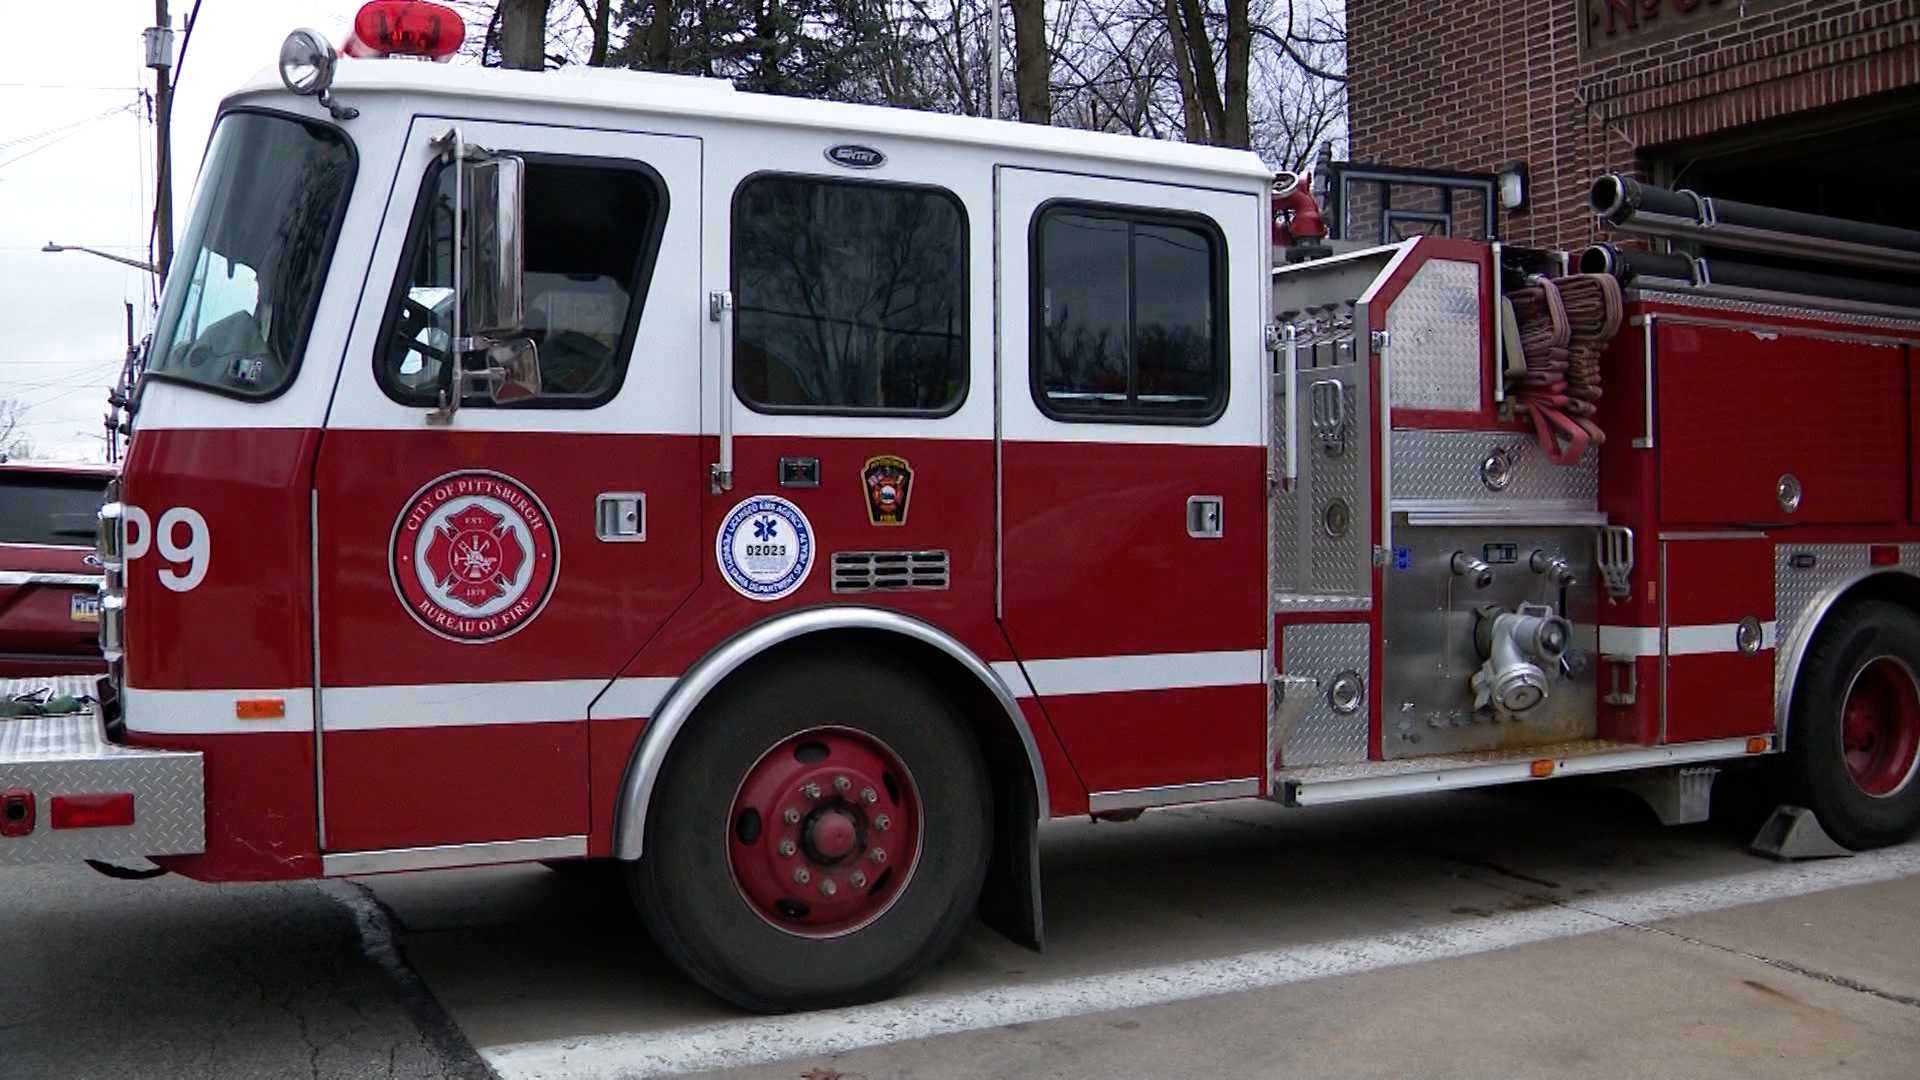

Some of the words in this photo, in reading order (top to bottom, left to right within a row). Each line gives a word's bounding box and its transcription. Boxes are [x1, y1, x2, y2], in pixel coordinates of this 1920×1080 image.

[407, 496, 435, 531] CITY
[435, 484, 457, 500] OF
[458, 480, 544, 530] PITTSBURGH
[121, 505, 211, 592] P9
[746, 545, 786, 556] 02023
[419, 600, 475, 632] BUREAU
[478, 619, 498, 632] OF
[502, 598, 534, 624] FIRE
